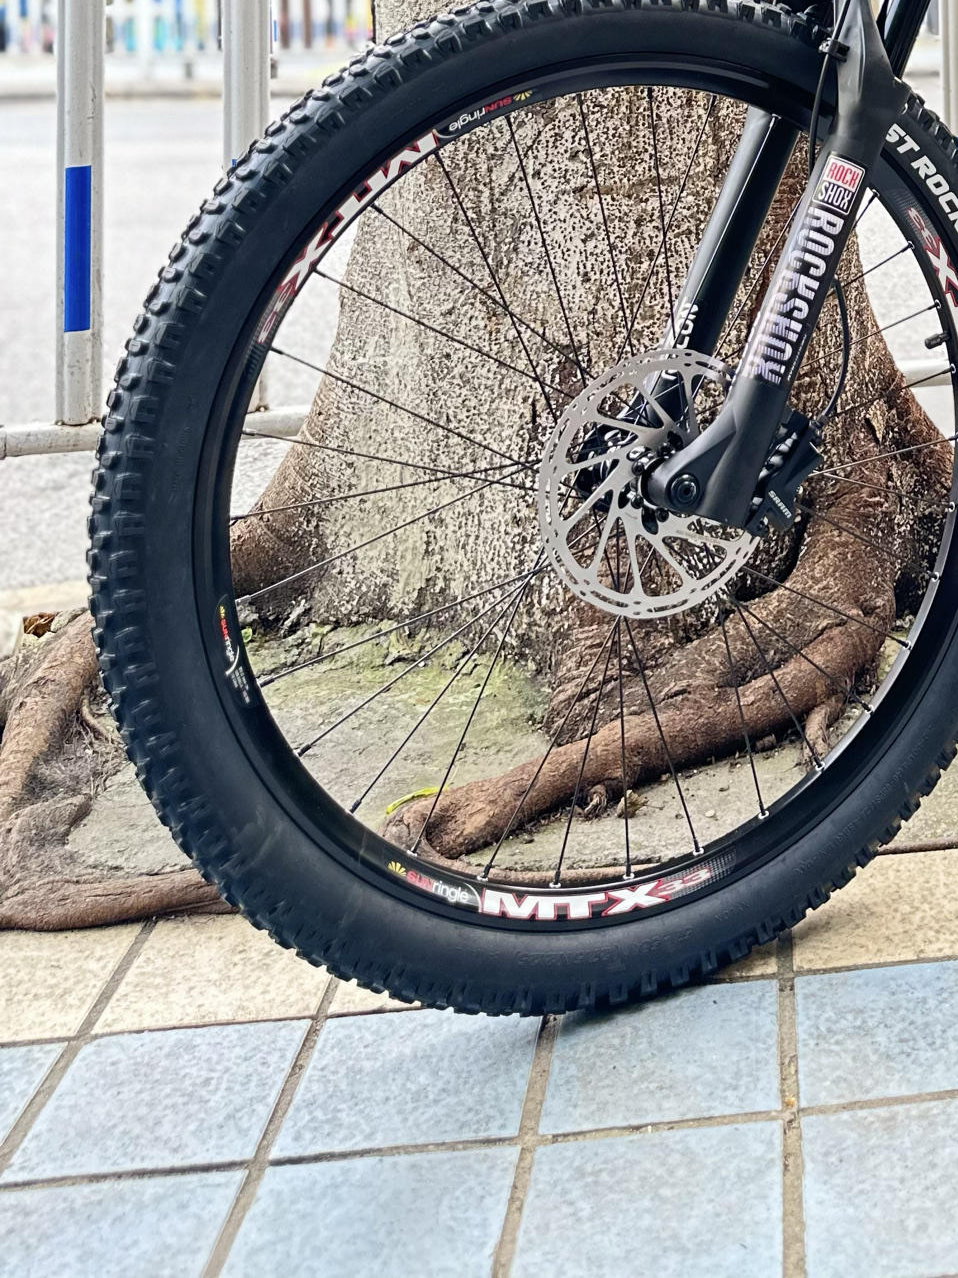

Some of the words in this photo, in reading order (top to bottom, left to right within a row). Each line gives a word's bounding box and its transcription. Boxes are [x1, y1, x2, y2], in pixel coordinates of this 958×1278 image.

[886, 124, 920, 153] ST
[826, 161, 860, 189] ROCK
[817, 183, 851, 210] SHOX
[768, 490, 793, 519] SRAM
